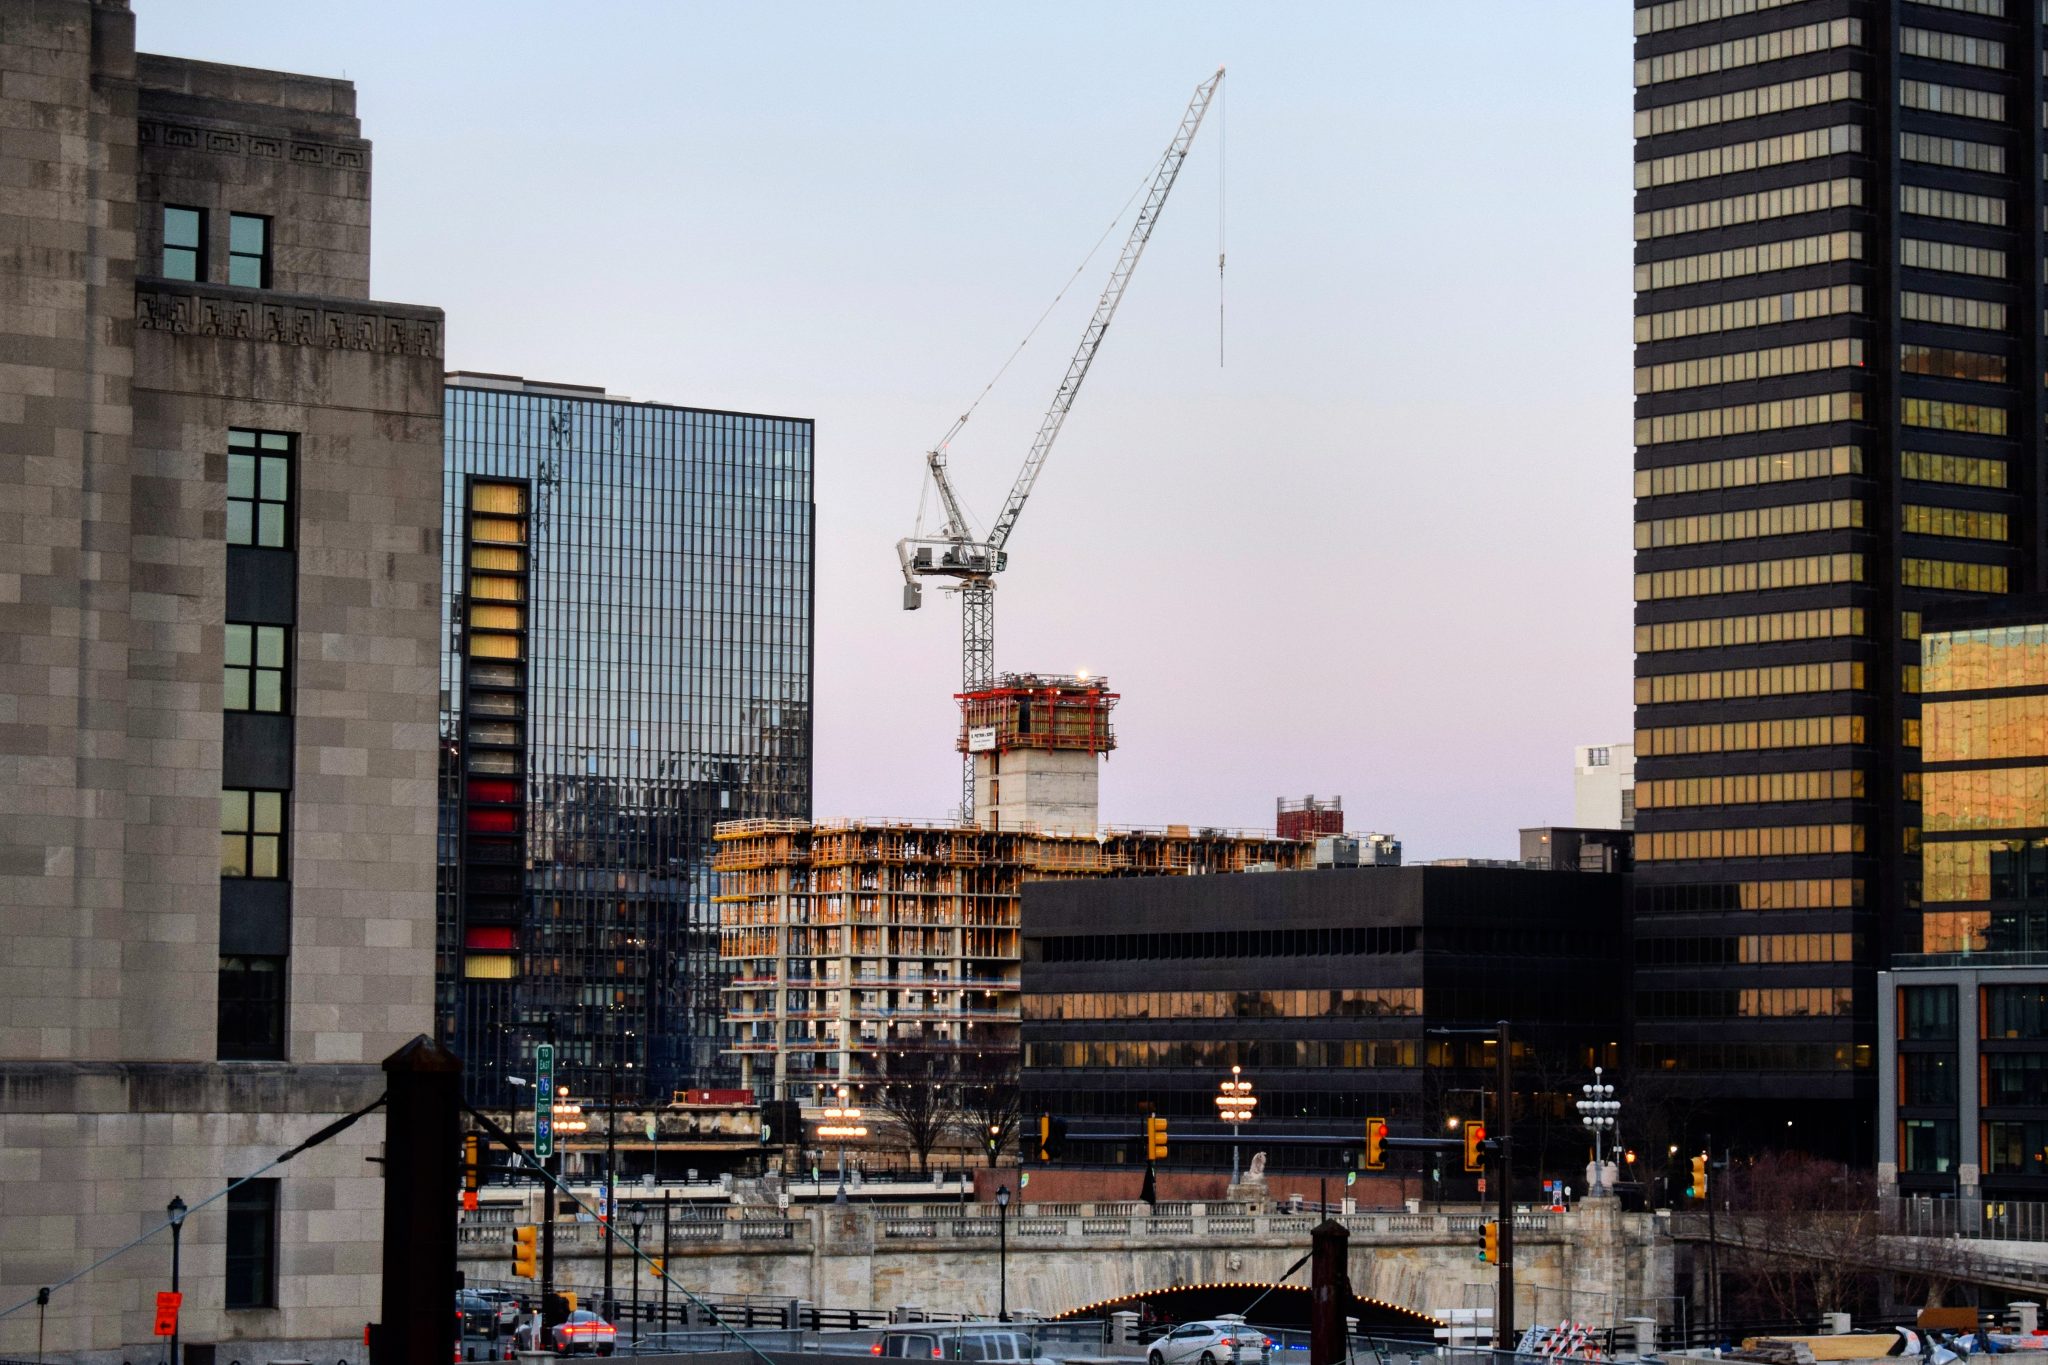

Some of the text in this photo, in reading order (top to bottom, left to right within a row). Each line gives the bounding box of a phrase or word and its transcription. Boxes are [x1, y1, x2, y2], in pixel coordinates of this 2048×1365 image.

[541, 1048, 549, 1057] TO
[539, 1059, 550, 1069] EAST
[540, 1078, 549, 1091] 76
[537, 1102, 551, 1112] SOUTH
[539, 1121, 549, 1134] 95
